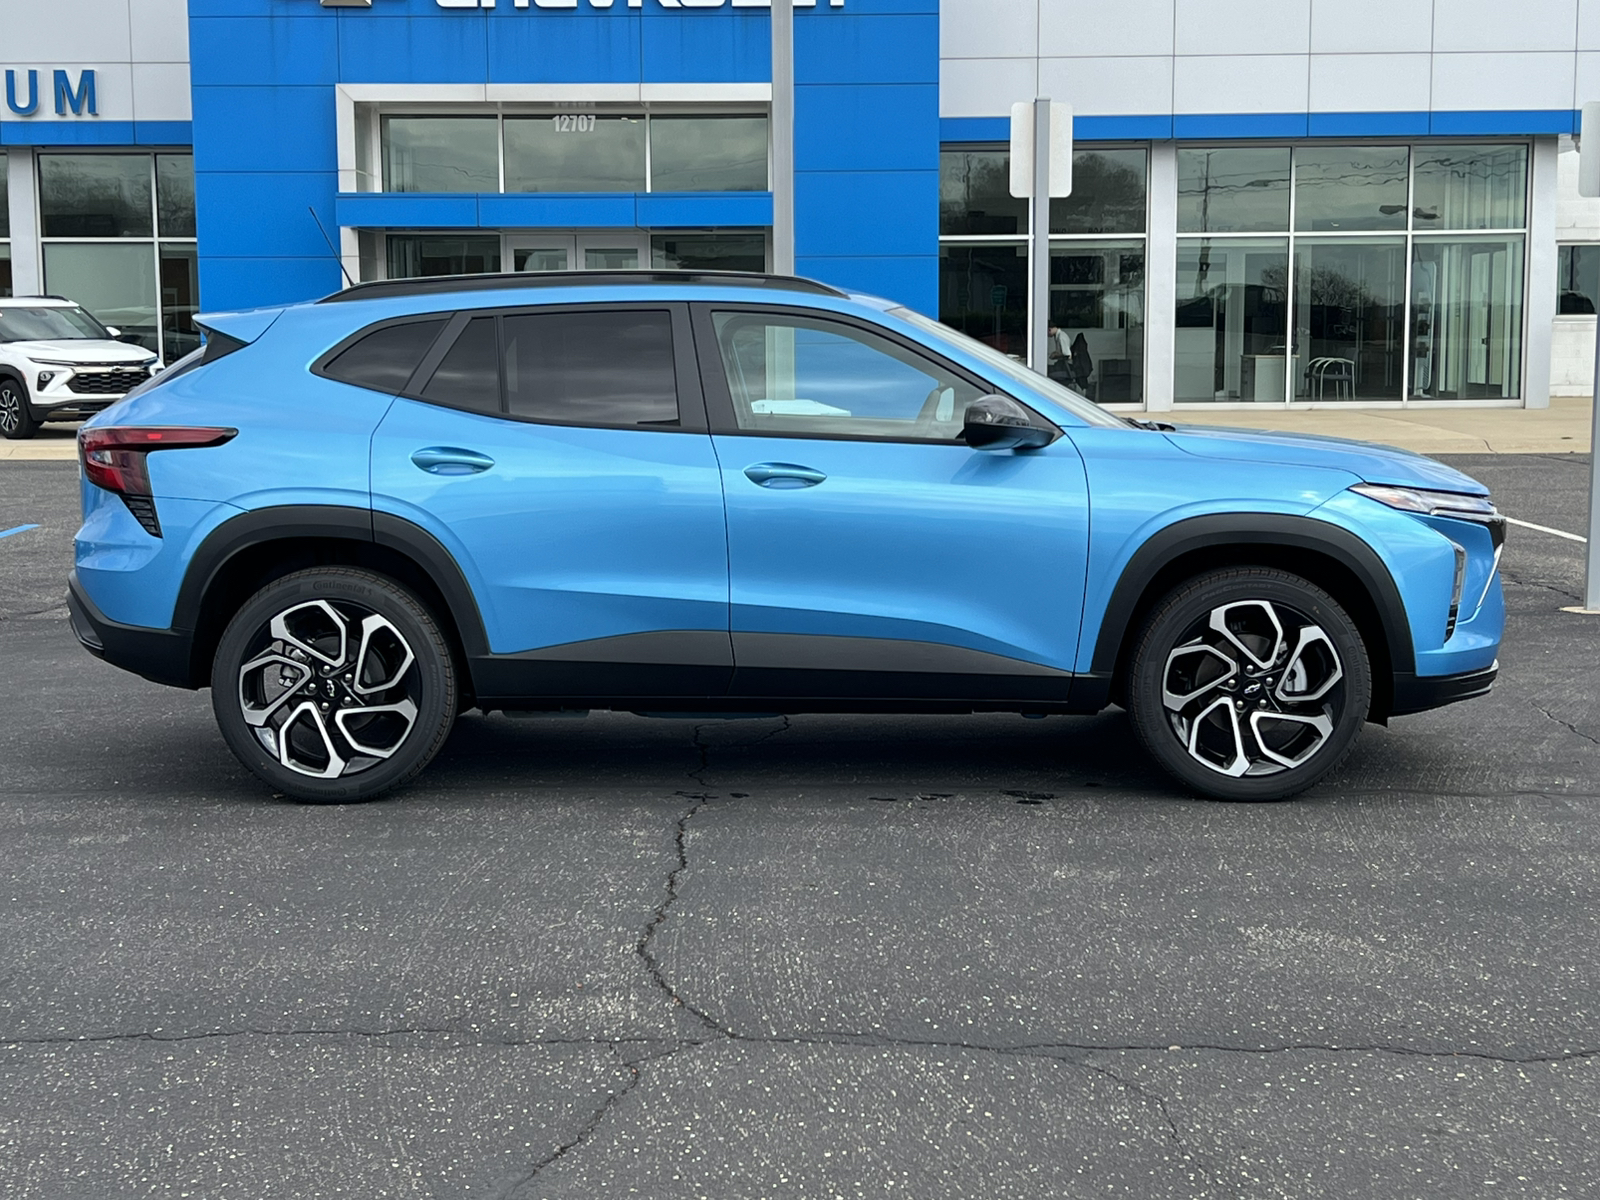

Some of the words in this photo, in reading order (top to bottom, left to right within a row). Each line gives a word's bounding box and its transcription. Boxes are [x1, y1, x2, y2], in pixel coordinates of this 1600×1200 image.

[5, 69, 98, 116] UM
[552, 114, 596, 132] 12707
[312, 580, 366, 594] Continental
